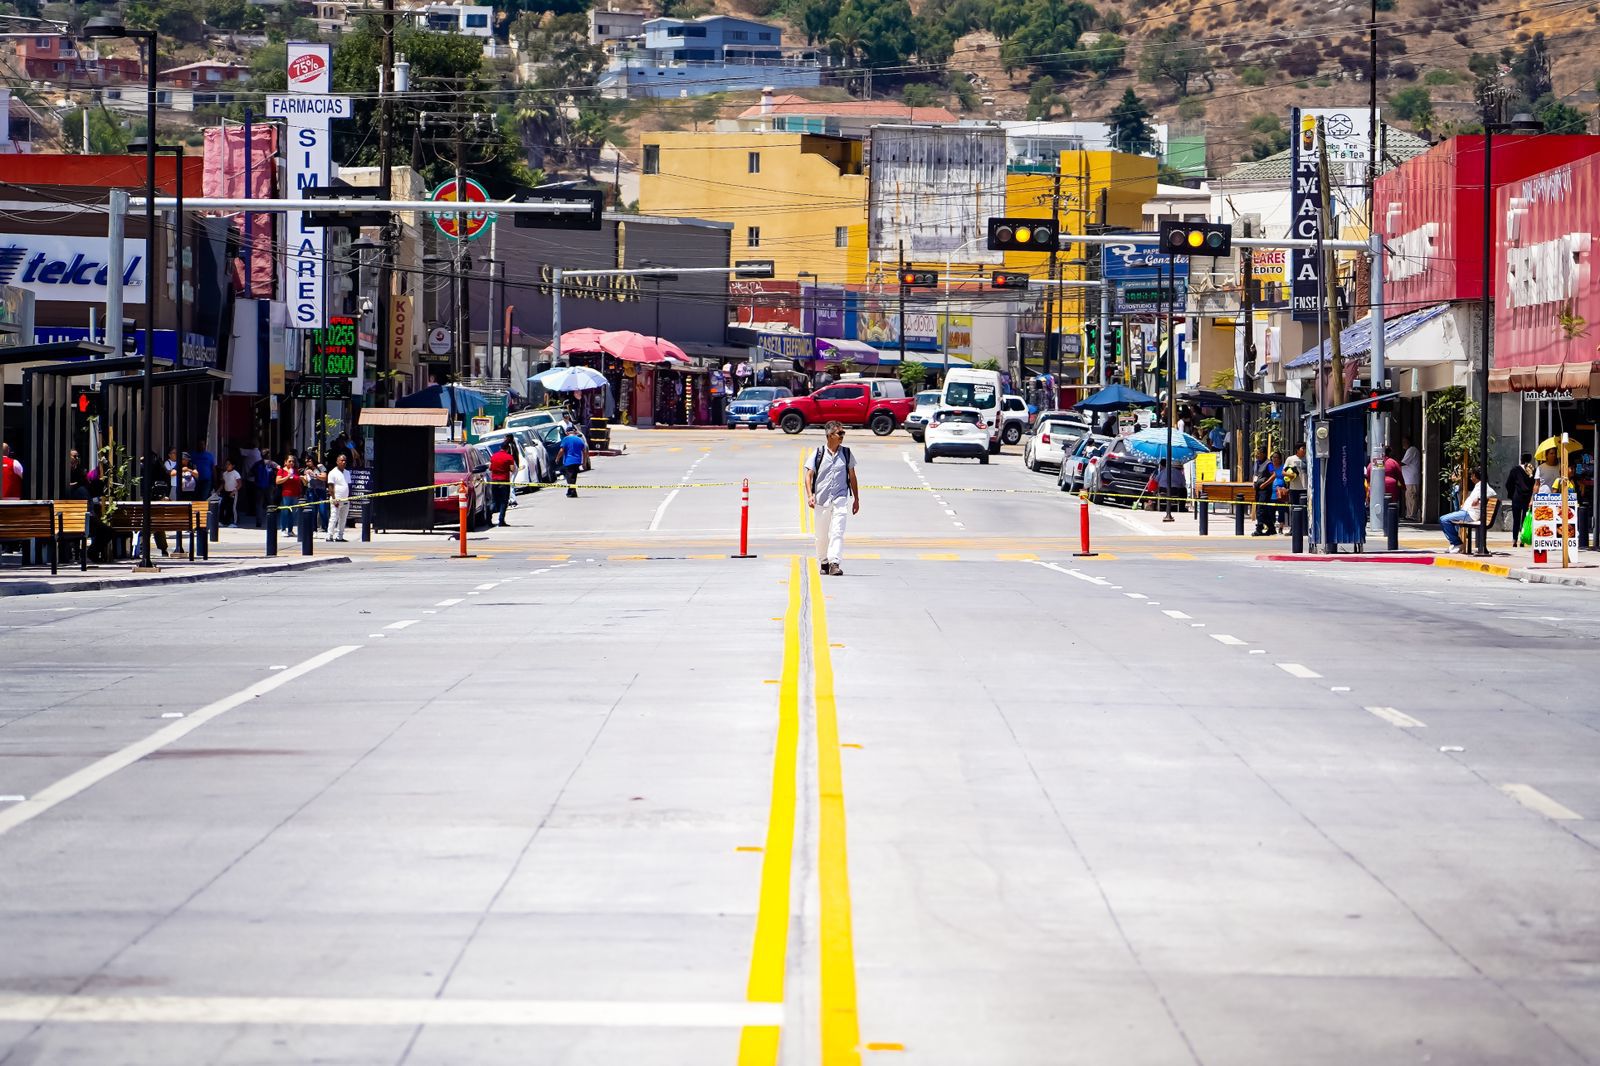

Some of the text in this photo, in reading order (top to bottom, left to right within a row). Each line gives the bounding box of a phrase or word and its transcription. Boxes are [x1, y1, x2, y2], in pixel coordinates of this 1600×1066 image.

[293, 58, 319, 76] 75%
[272, 98, 343, 114] FARMACIAS
[1349, 150, 1365, 159] Tea
[297, 128, 319, 322] SIMLARES
[393, 301, 406, 360] Kodak
[758, 336, 781, 354] CASETA
